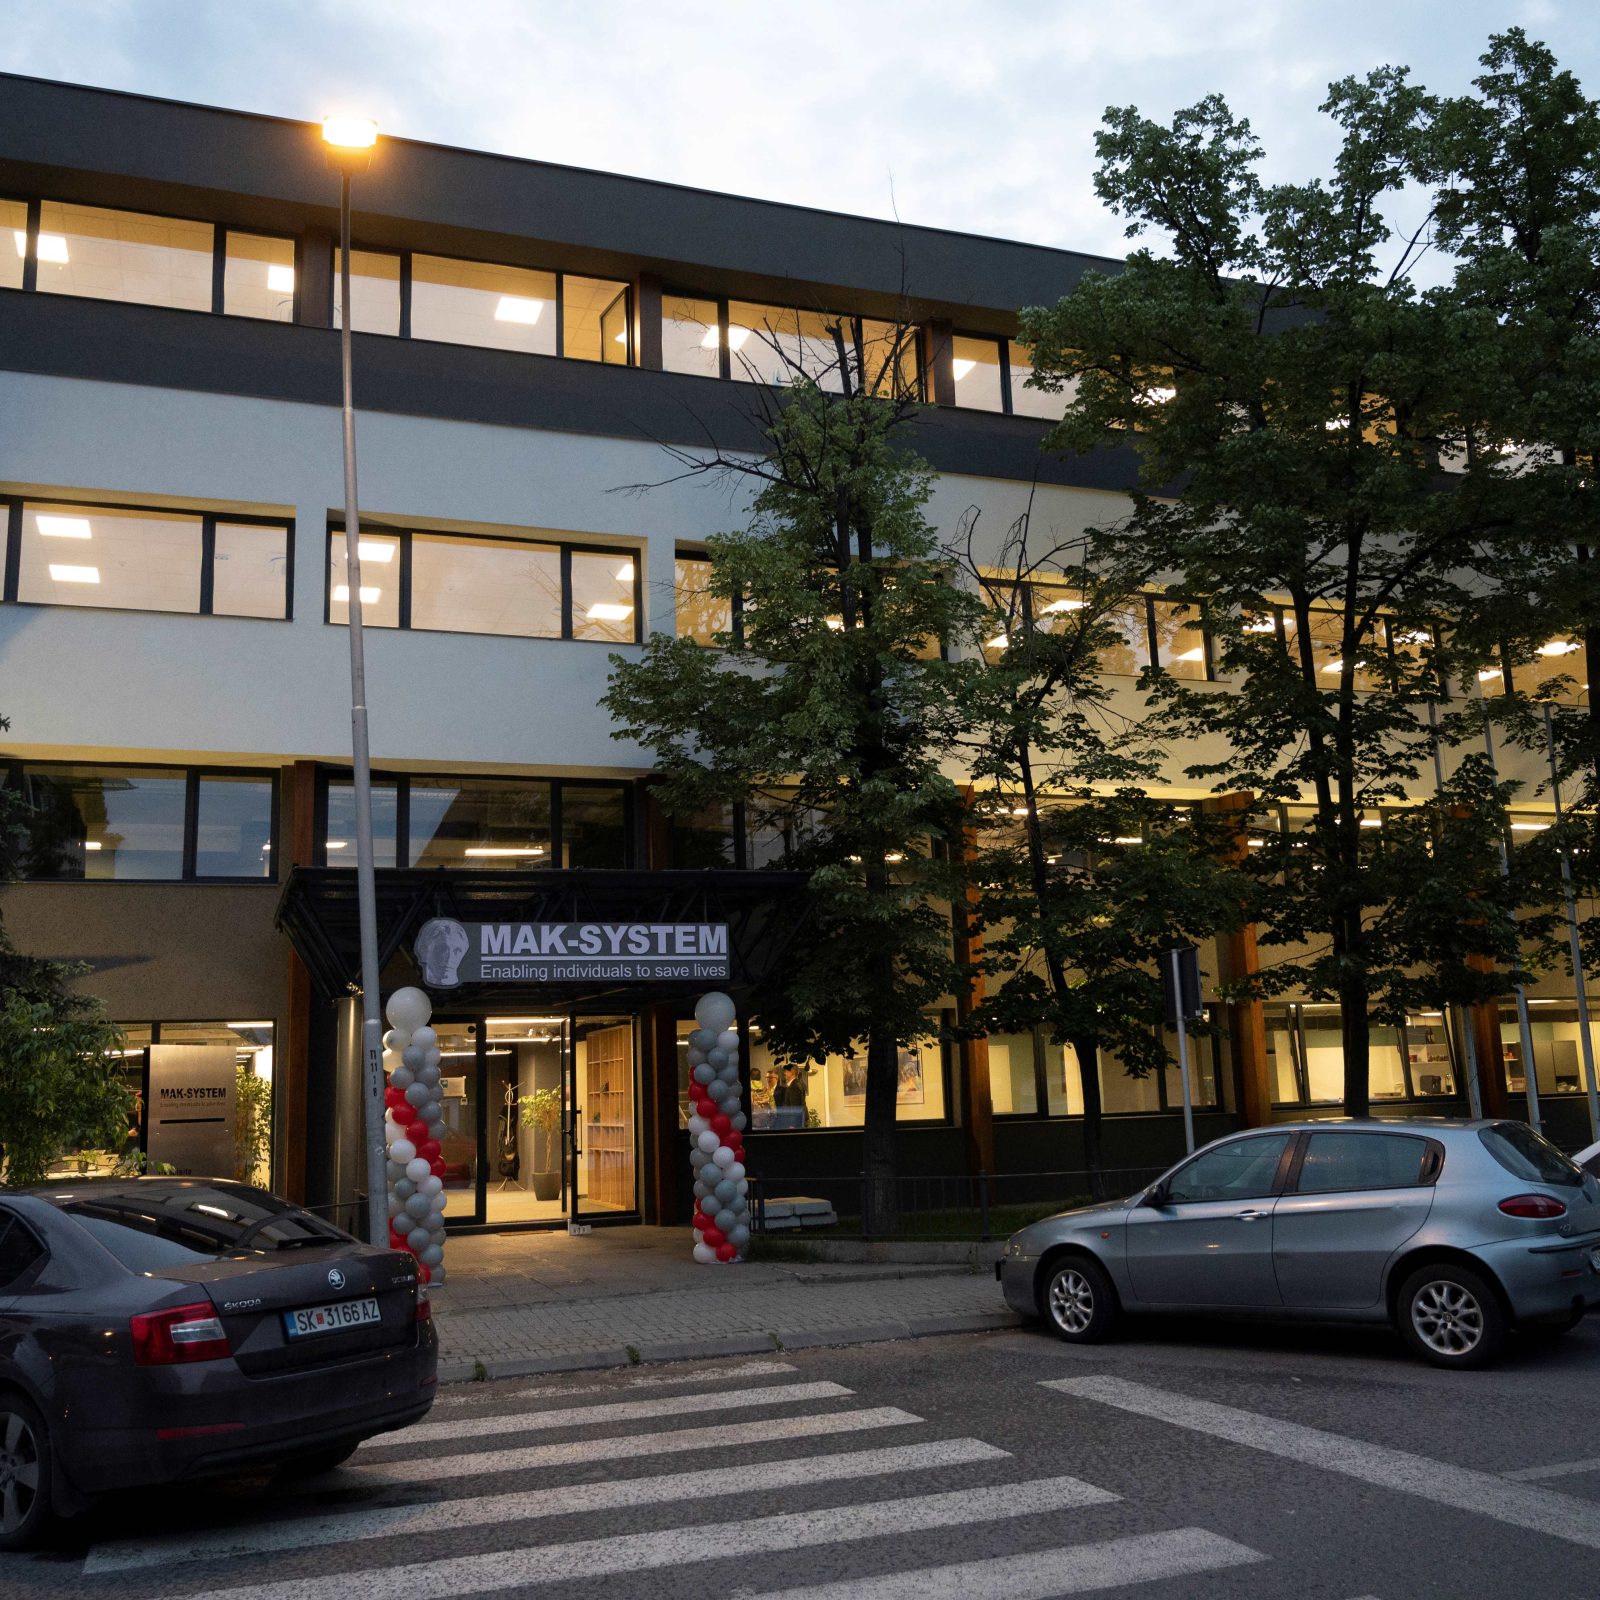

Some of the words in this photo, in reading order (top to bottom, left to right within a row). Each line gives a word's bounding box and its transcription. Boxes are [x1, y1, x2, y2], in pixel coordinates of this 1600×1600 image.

[481, 925, 727, 954] MAK-SYSTEM
[481, 964, 548, 981] Enabling
[553, 964, 632, 978] individuals
[637, 965, 650, 977] to
[655, 967, 689, 977] save
[694, 963, 726, 977] lives
[160, 1088, 226, 1099] MAK-SYSTEM
[297, 1310, 319, 1332] SK
